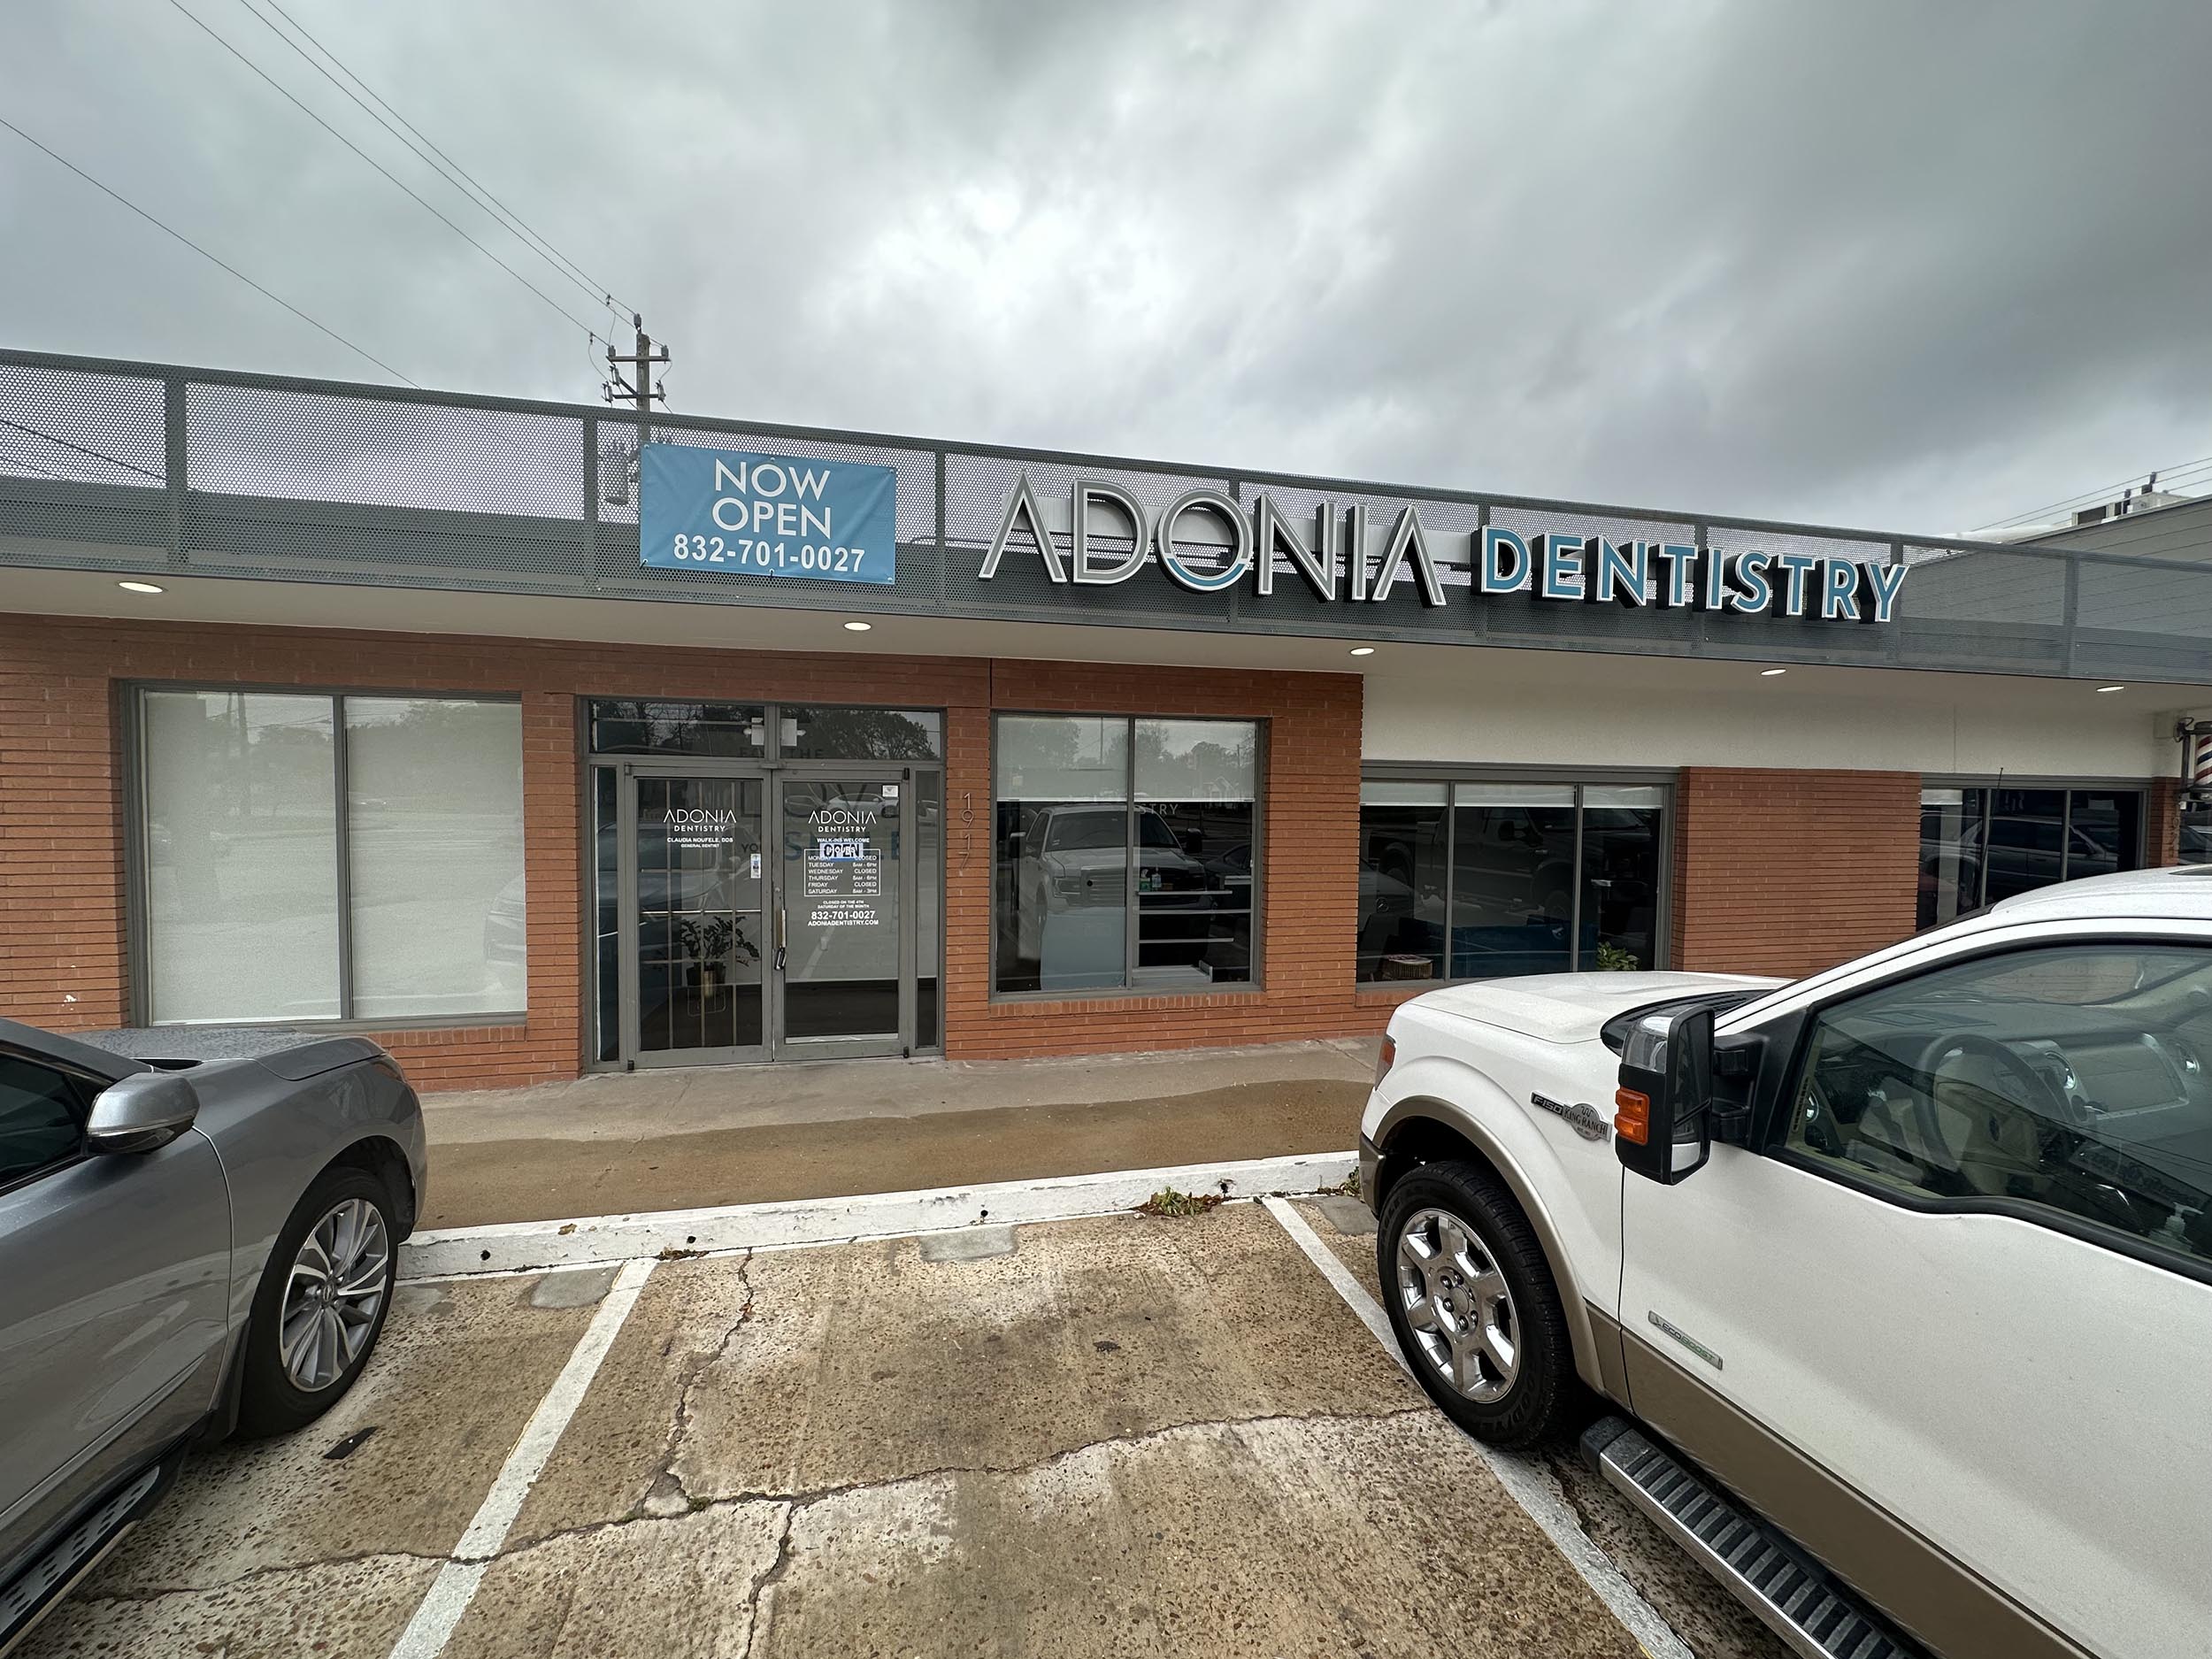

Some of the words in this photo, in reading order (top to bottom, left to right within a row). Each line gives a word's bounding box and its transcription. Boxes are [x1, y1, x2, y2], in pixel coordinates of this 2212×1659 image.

[715, 458, 831, 501] NOW
[712, 497, 832, 540] OPEN
[673, 534, 865, 572] 832-701-0027
[978, 470, 1448, 608] ADONIA
[1479, 523, 1908, 625] DENTISTRY
[663, 809, 737, 823] ADONIA
[808, 810, 877, 824] ADONIA
[824, 843, 859, 857] OPEN
[810, 910, 876, 919] 832-701-0027
[1563, 1107, 1581, 1125] KING
[1581, 1117, 1607, 1135] RANCH
[1663, 1323, 1715, 1362] ECOBOOST
